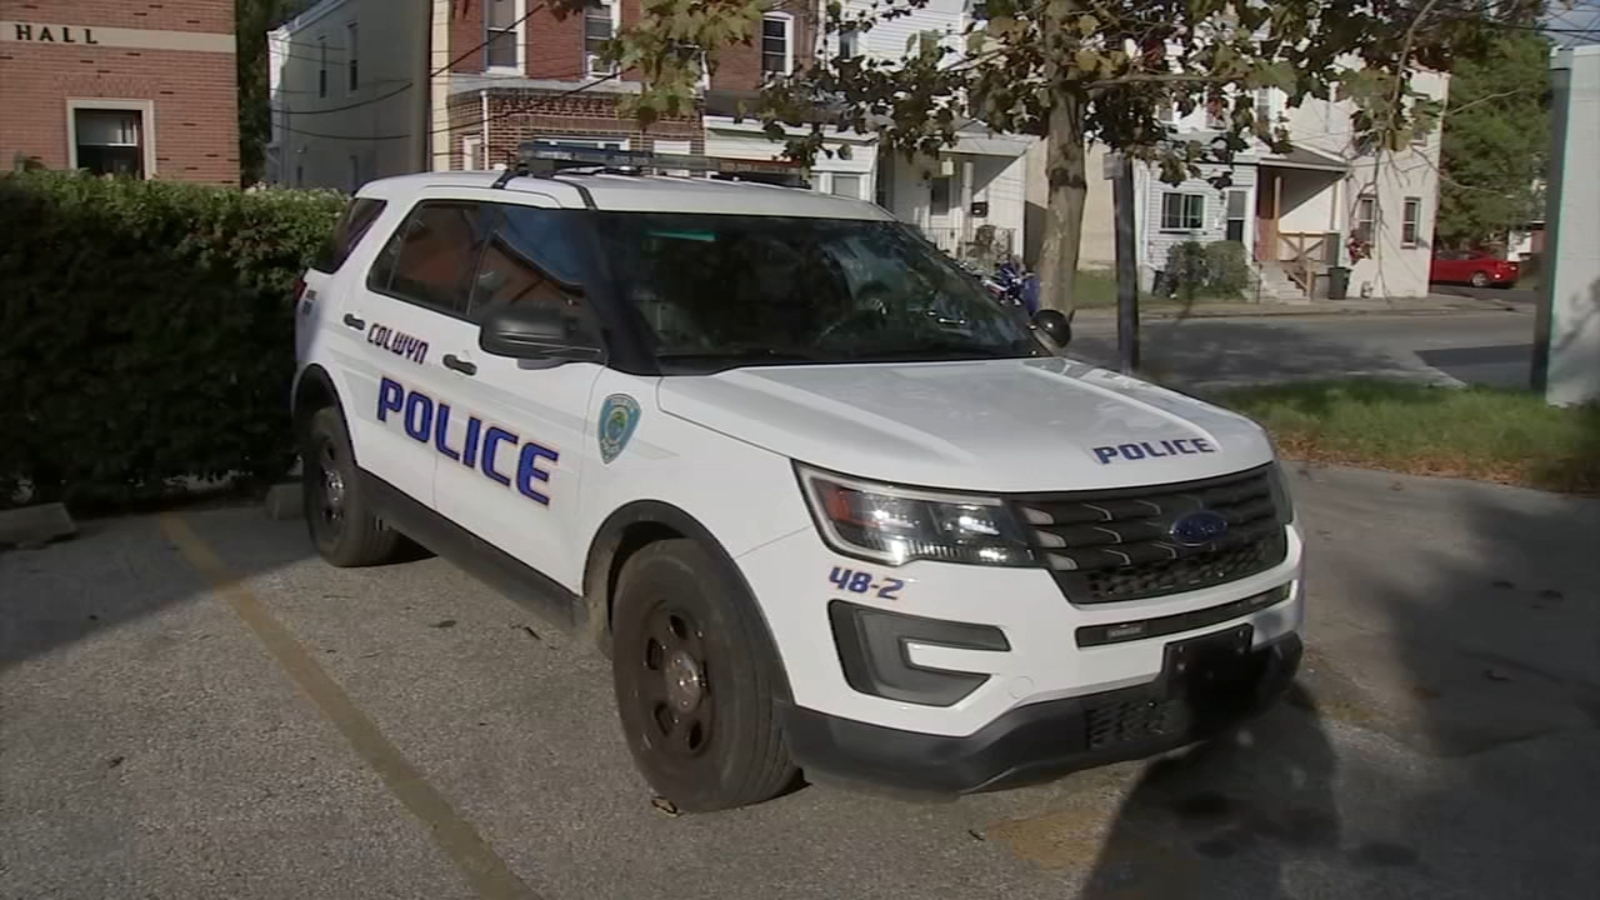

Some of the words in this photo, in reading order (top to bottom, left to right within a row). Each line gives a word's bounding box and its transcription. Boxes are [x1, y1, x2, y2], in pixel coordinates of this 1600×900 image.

[15, 24, 98, 44] HALL
[367, 323, 429, 365] COLWYN
[377, 375, 560, 506] POLICE
[1093, 438, 1215, 464] POLICE
[829, 566, 904, 600] 48-2
